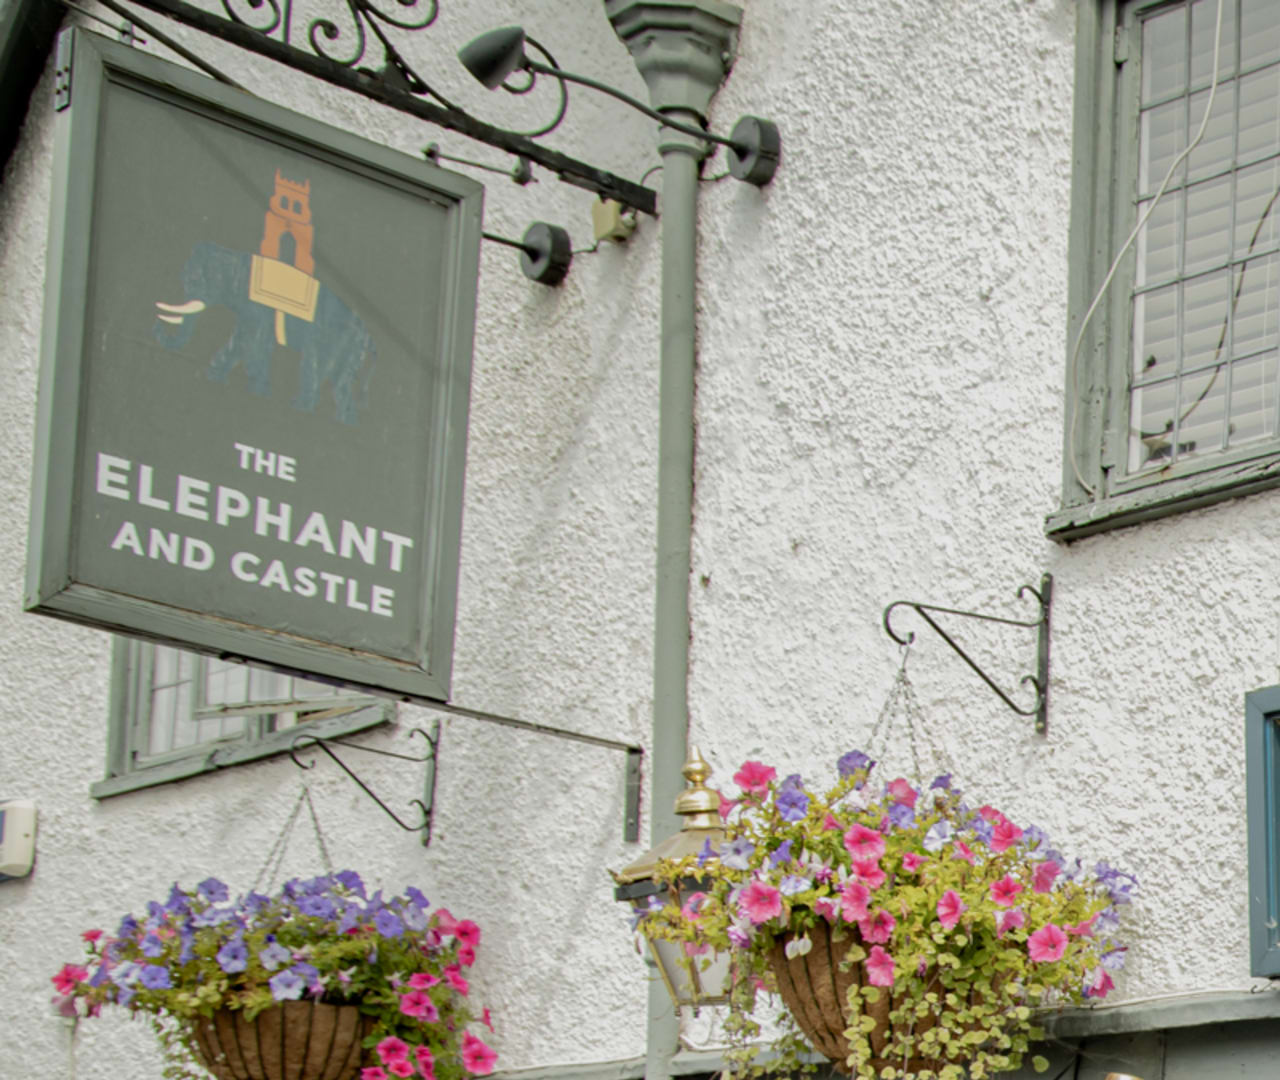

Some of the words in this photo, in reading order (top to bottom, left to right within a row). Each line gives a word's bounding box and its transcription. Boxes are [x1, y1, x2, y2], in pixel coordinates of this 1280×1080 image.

[234, 441, 296, 482] THE
[96, 451, 414, 572] ELEPHANT
[110, 521, 215, 572] AND
[230, 551, 396, 618] CASTLE
